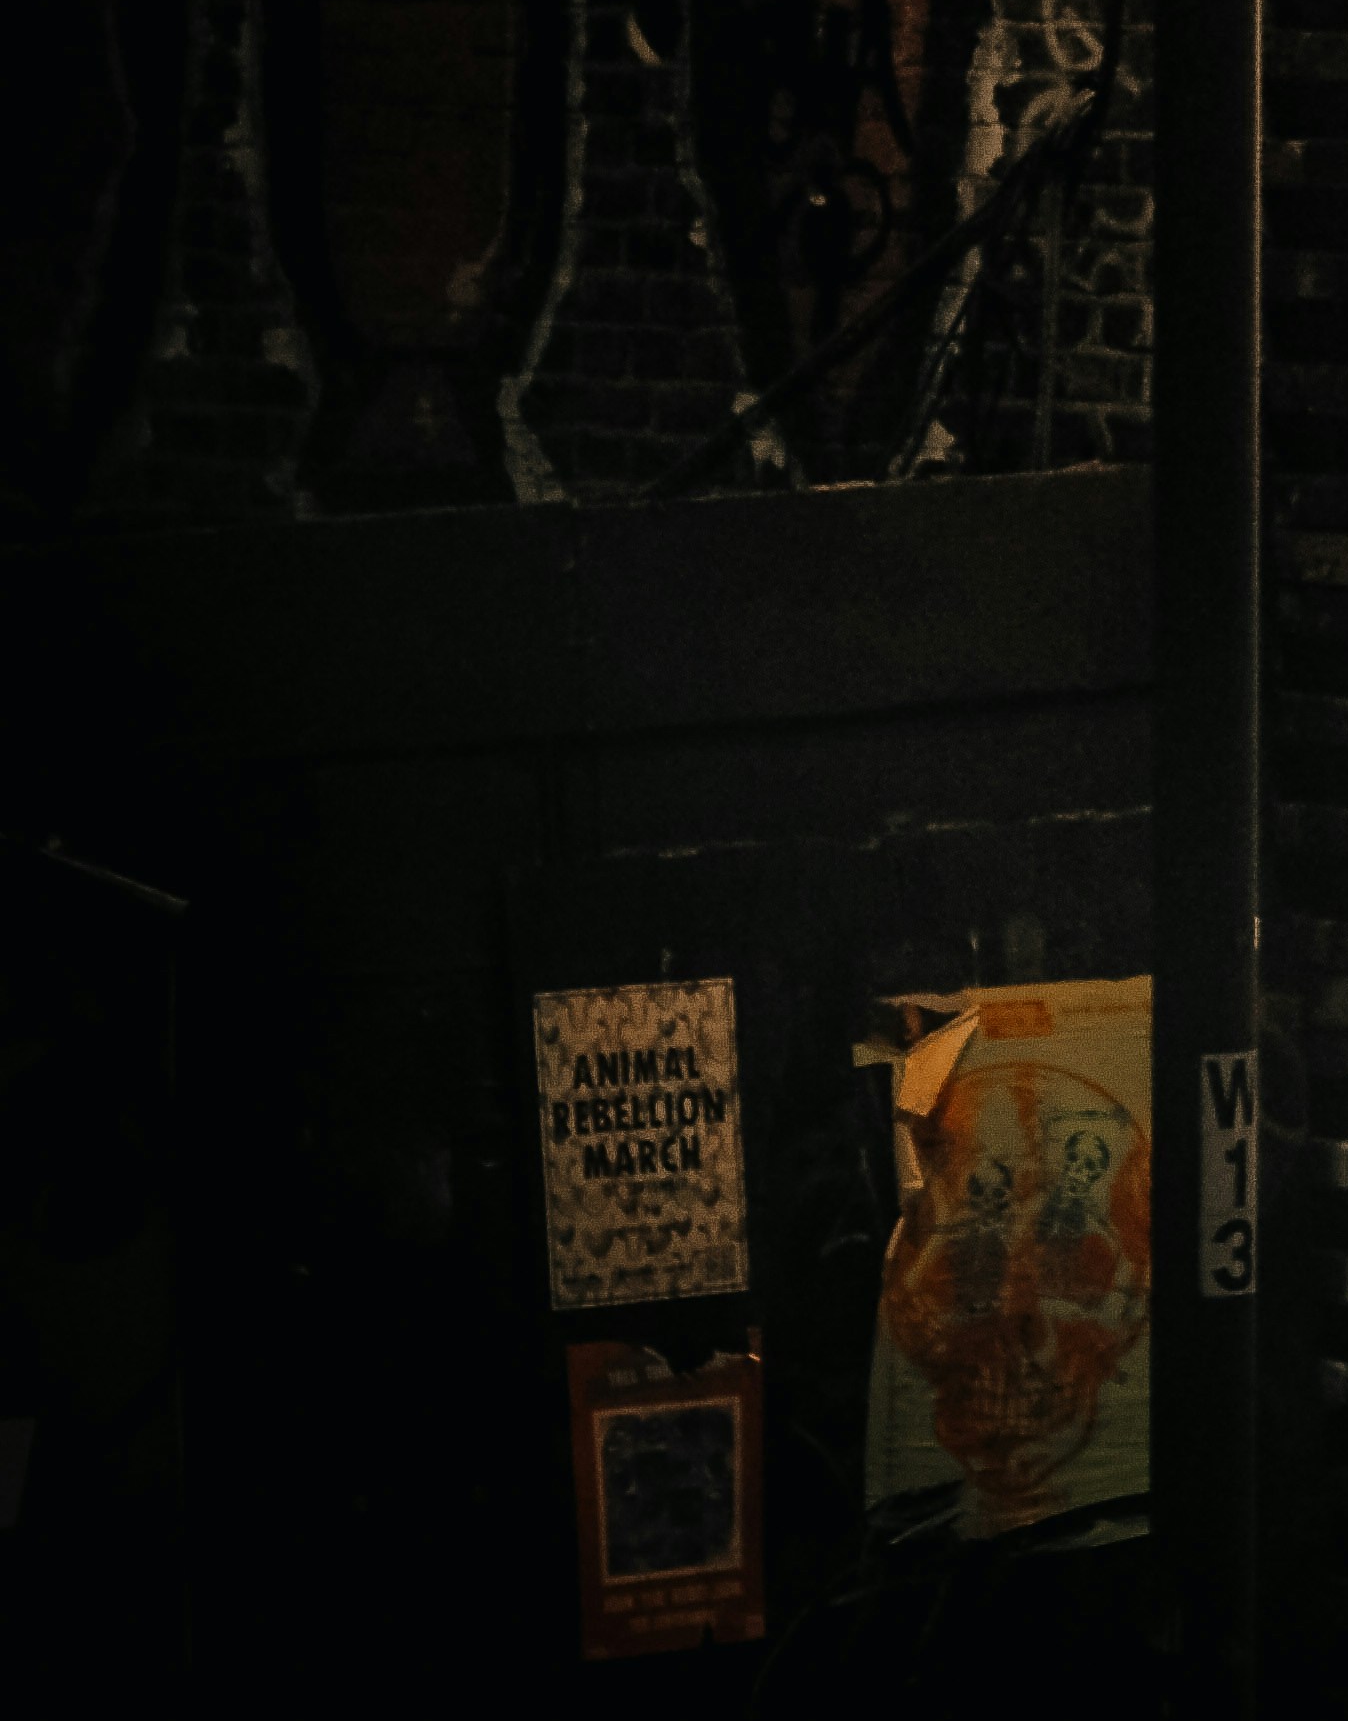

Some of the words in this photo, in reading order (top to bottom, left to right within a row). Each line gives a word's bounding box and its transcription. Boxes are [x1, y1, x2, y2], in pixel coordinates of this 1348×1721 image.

[573, 1046, 701, 1089] ANIMAL
[552, 1088, 726, 1137] REBELLION
[583, 1135, 702, 1179] MARCH
[1206, 1058, 1253, 1291] W13
